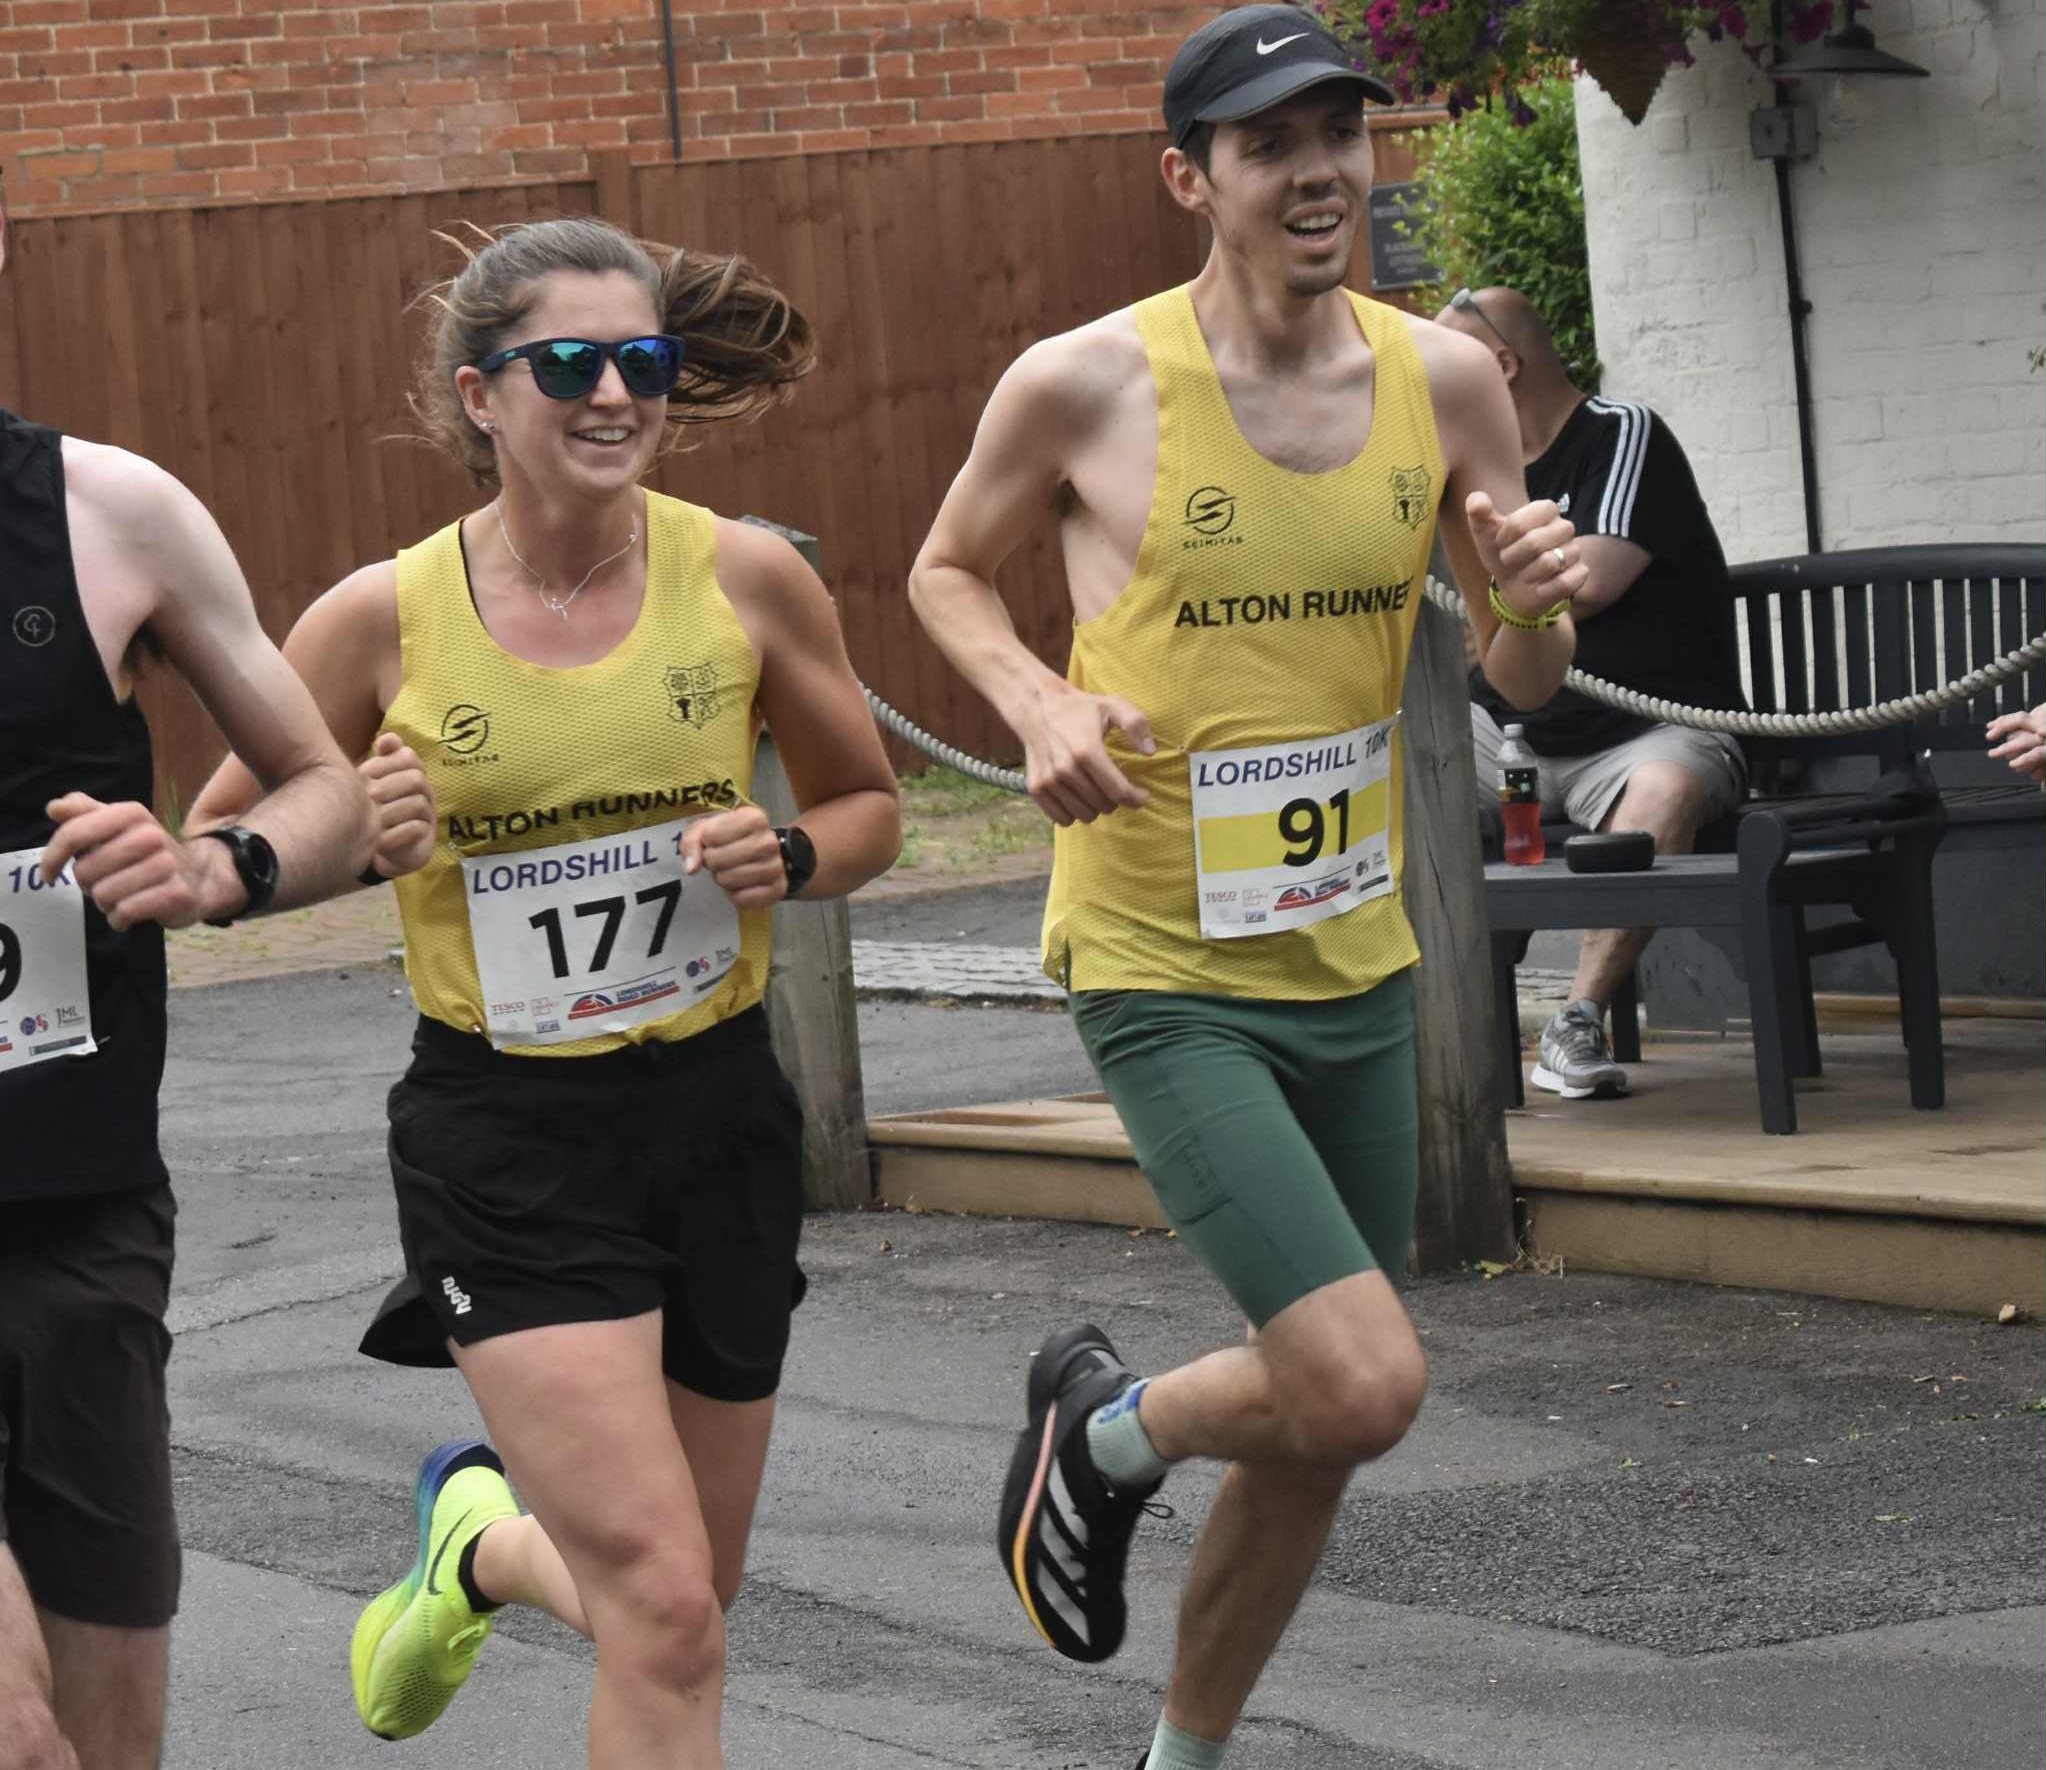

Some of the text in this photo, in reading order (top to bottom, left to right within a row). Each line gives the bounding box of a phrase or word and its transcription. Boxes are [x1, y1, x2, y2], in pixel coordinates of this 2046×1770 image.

[1174, 576, 1414, 628] ALTON RUNNE
[1198, 726, 1390, 788] LORDSHILL 10K
[447, 778, 736, 843] ALTON RUNNERS
[1278, 788, 1350, 867] 91
[473, 841, 658, 895] LORDSHILL
[528, 879, 682, 979] 177
